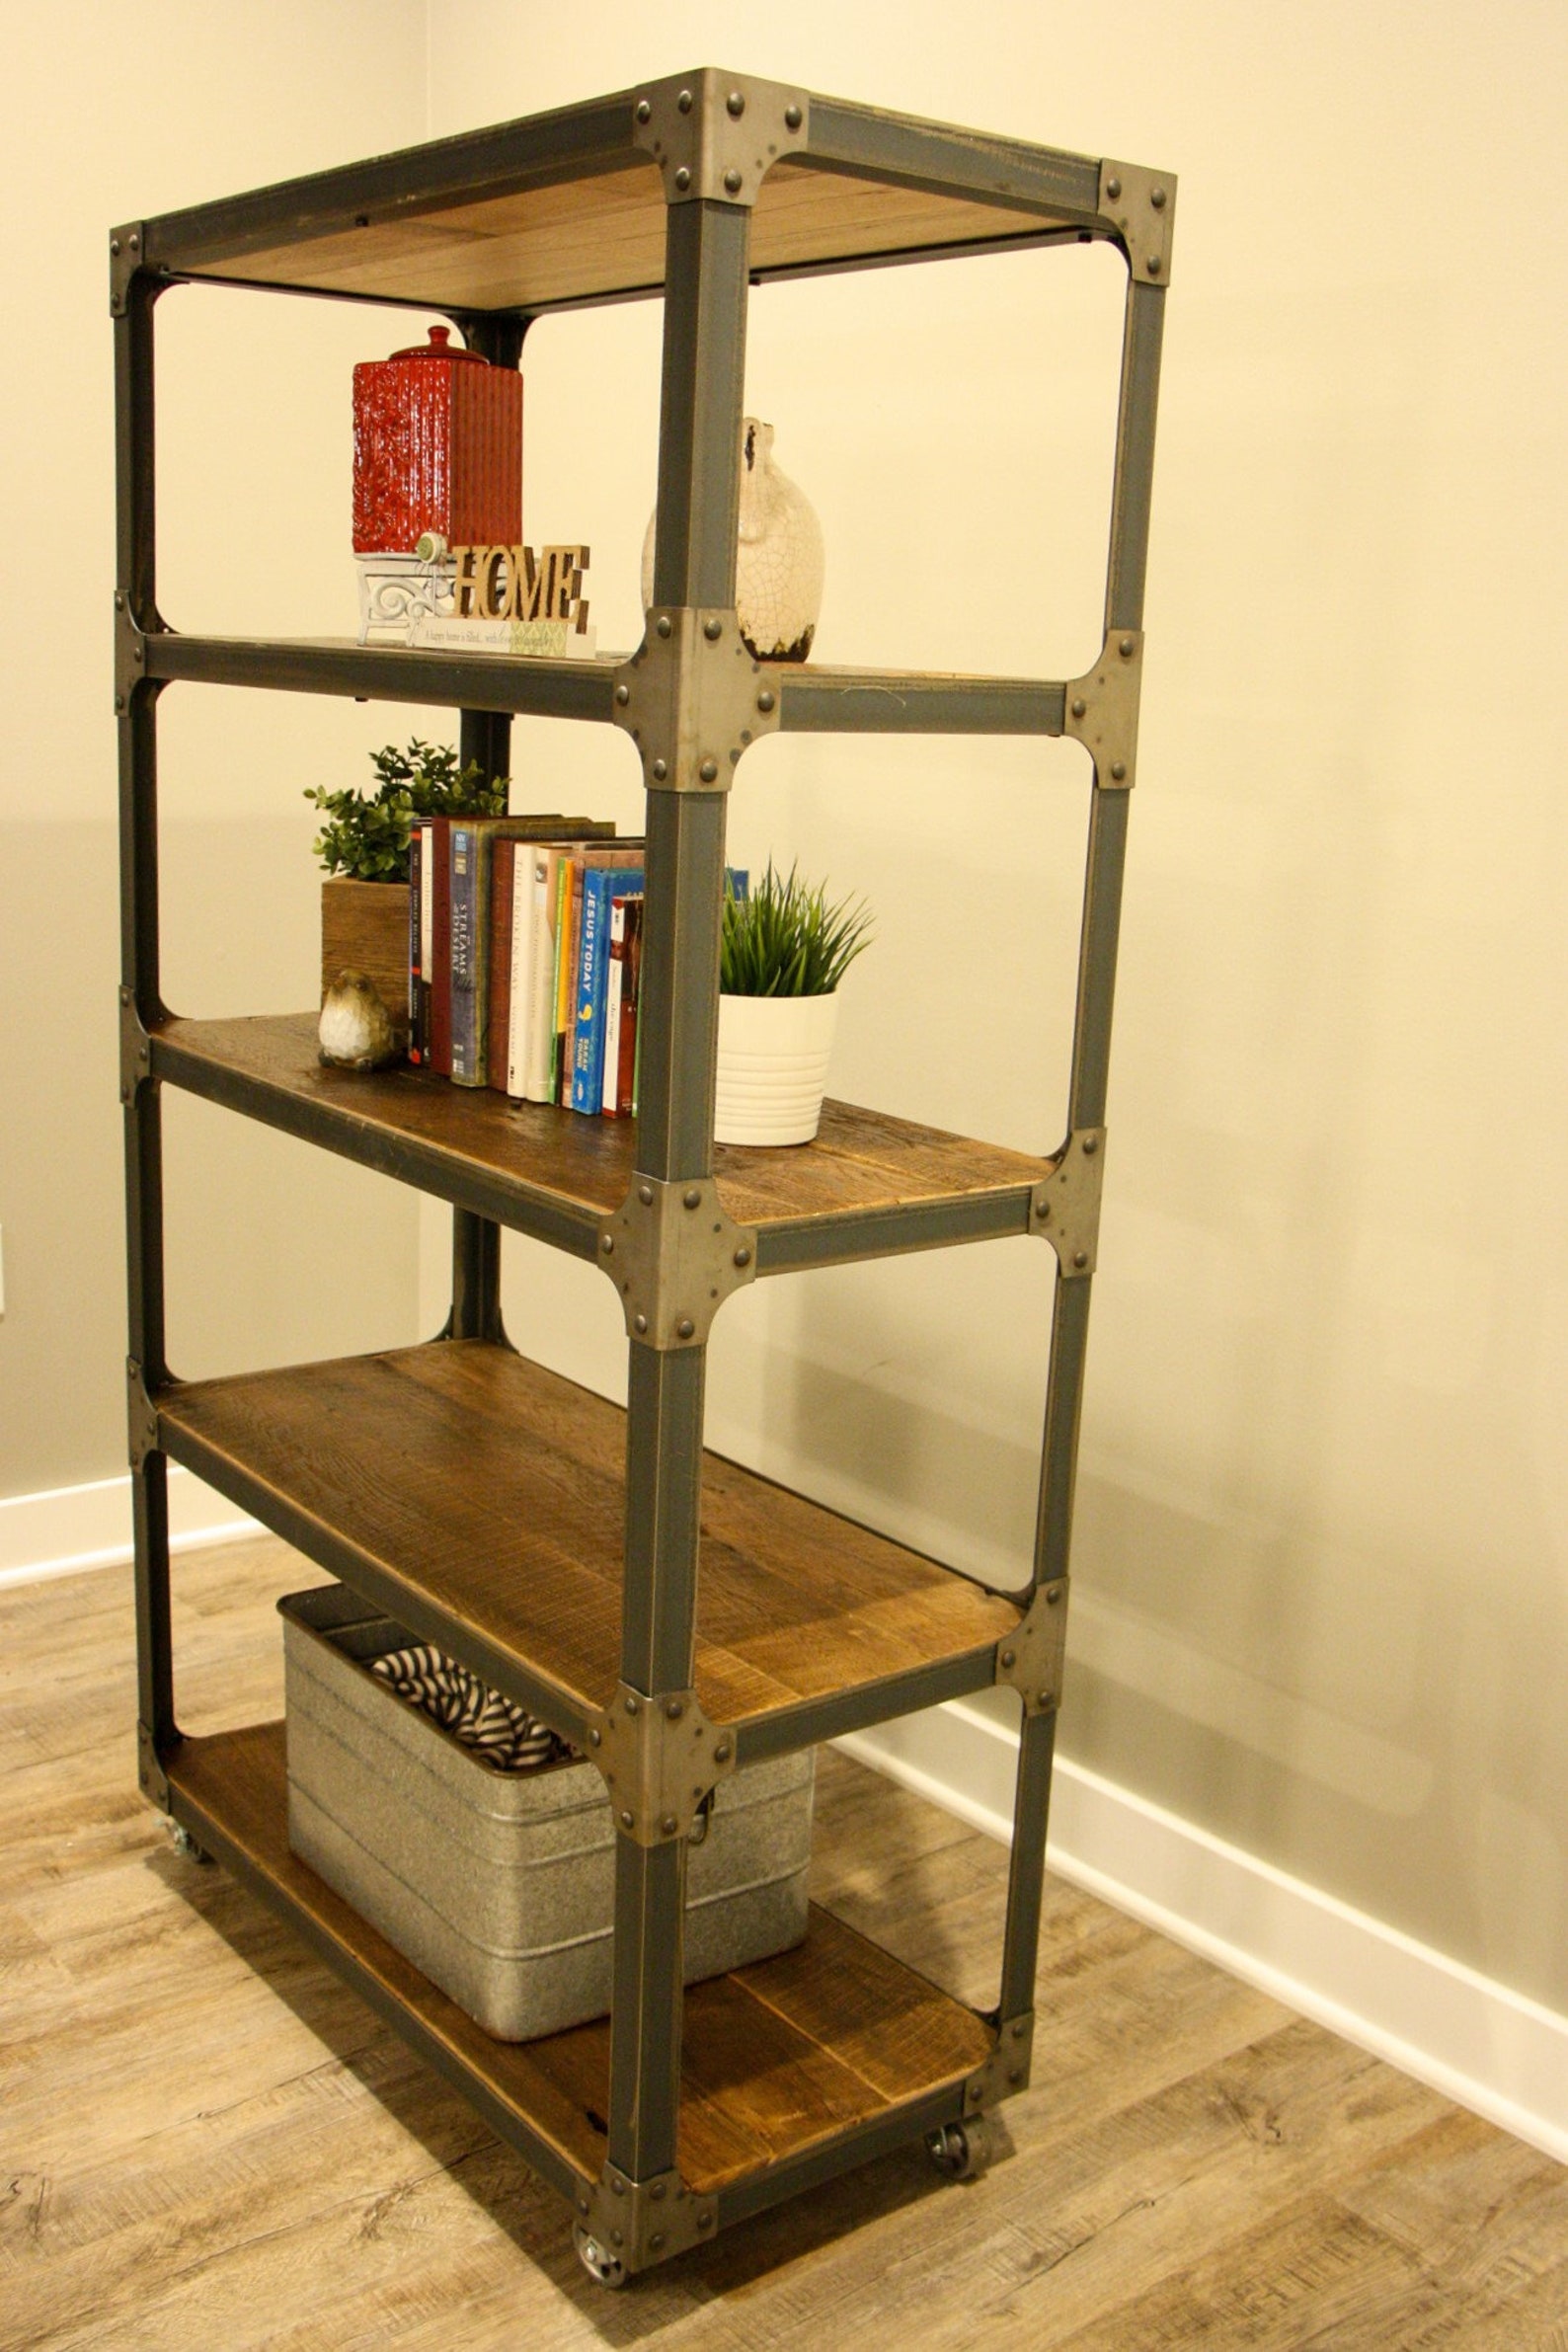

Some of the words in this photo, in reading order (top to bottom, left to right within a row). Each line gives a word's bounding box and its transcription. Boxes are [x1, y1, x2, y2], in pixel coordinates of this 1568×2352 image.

[451, 545, 589, 629] HOME
[451, 914, 460, 974] DESERT
[512, 895, 522, 955] BROKEN
[586, 890, 596, 940] JESUS
[583, 942, 594, 993] TODAY
